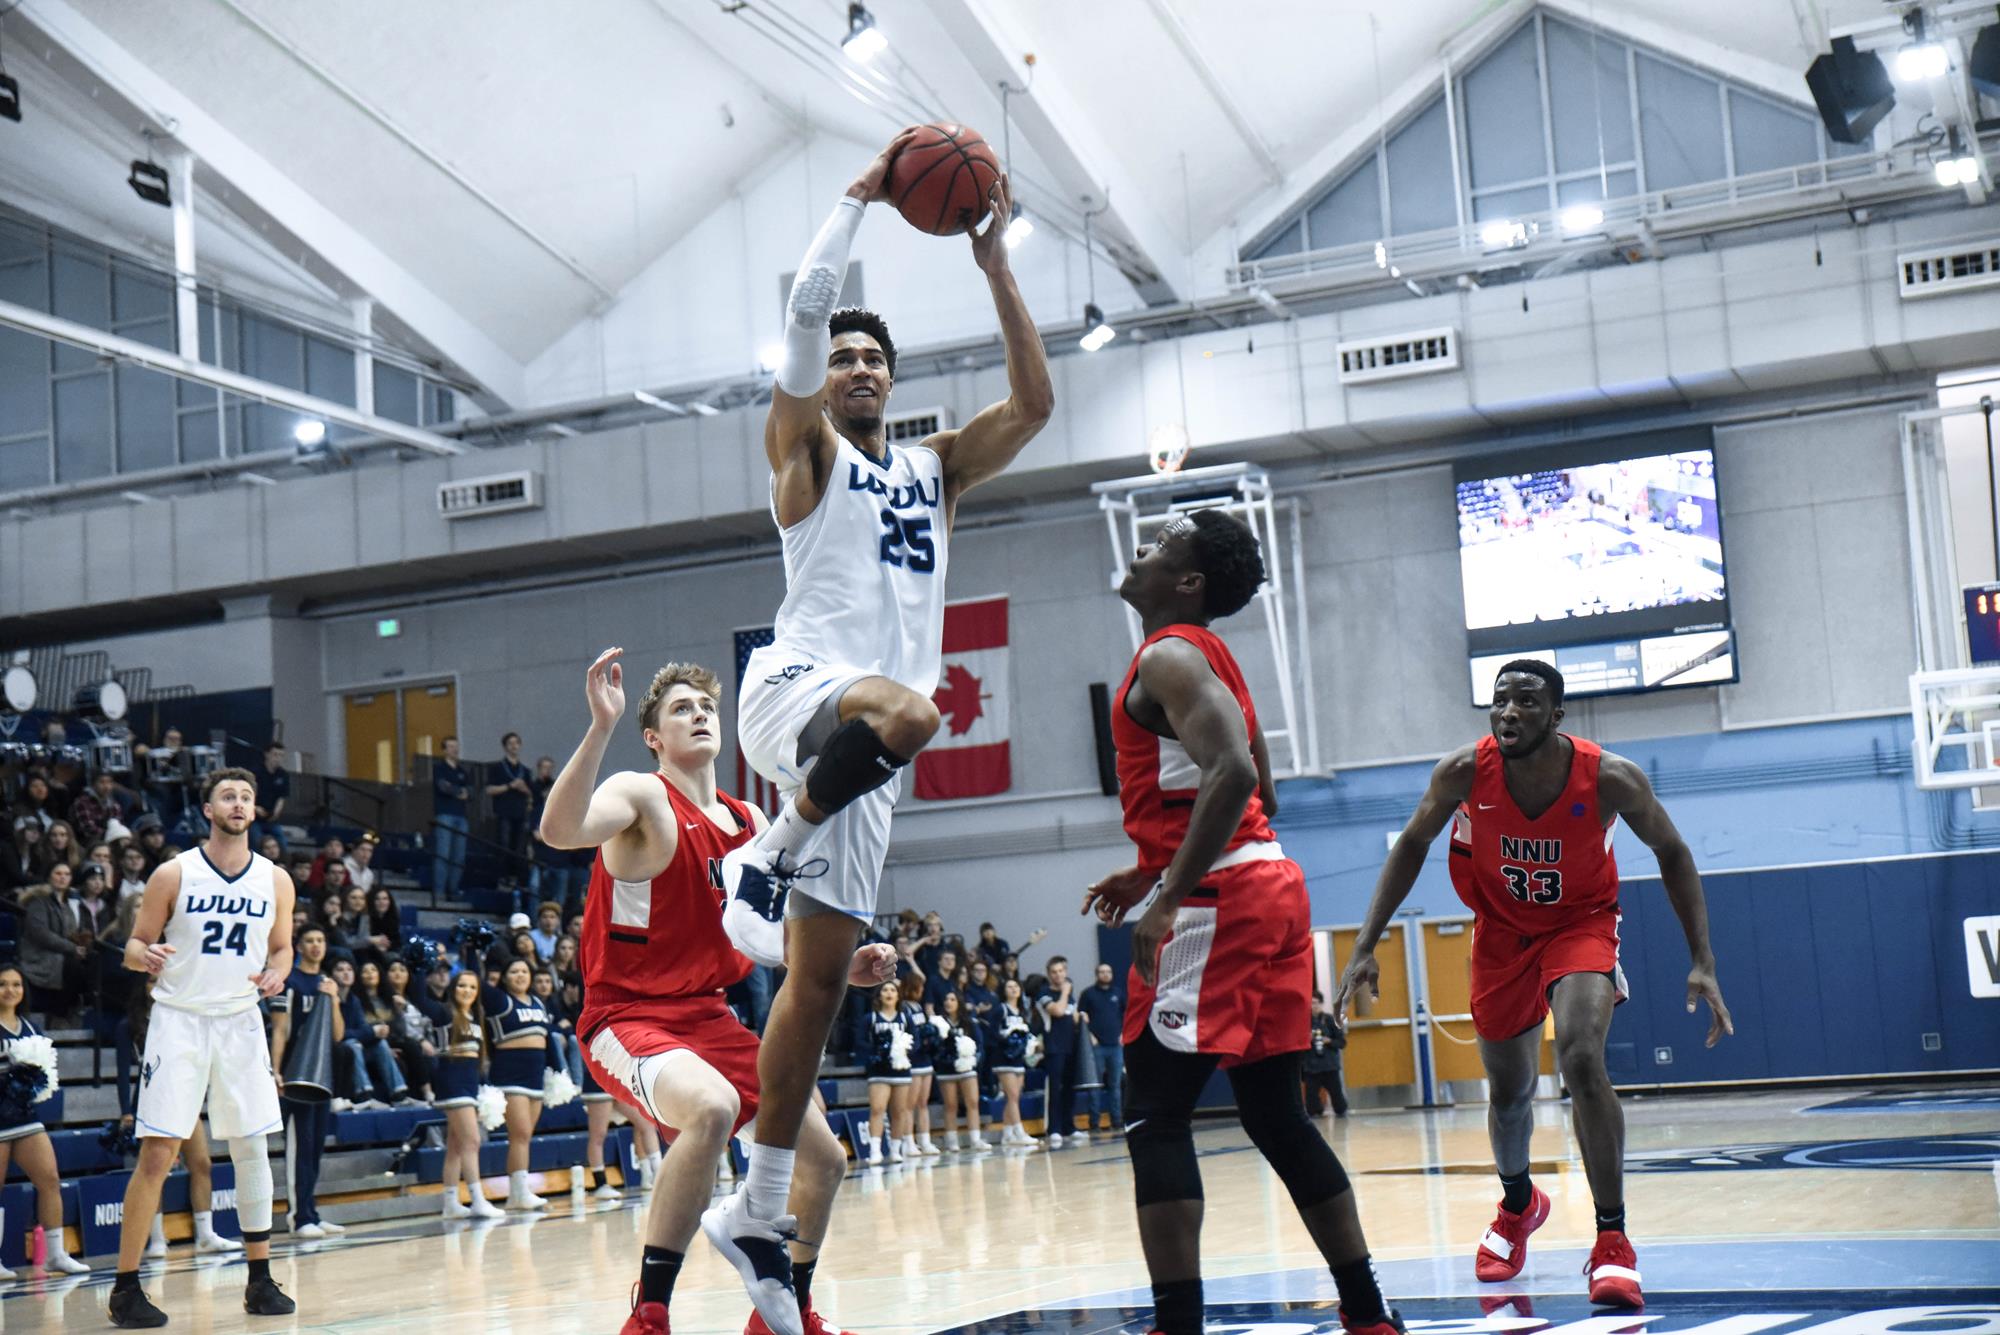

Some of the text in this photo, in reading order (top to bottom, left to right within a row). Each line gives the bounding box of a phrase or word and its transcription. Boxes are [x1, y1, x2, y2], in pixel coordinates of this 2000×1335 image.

[848, 461, 940, 509] WWU
[880, 508, 935, 574] 25
[1500, 834, 1562, 865] NNU
[1500, 865, 1562, 905] 33
[185, 894, 268, 918] WWU
[201, 920, 248, 957] 24
